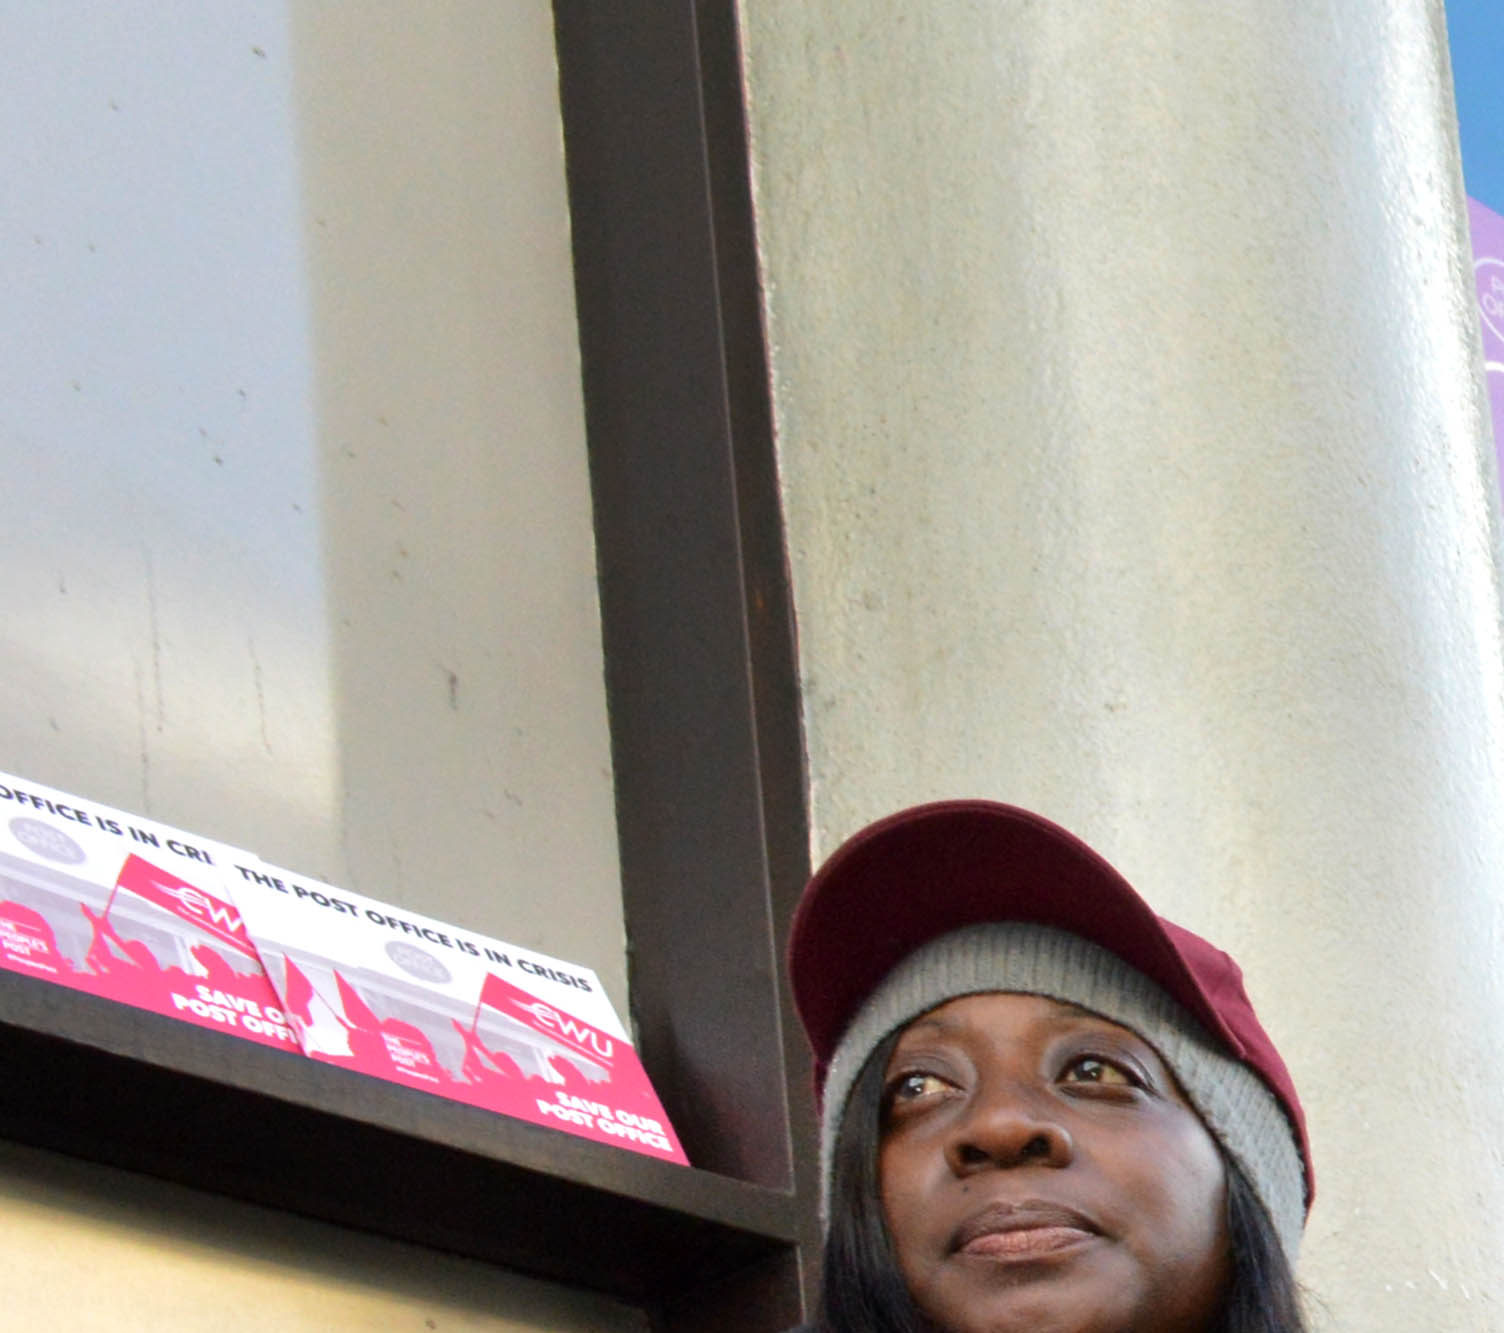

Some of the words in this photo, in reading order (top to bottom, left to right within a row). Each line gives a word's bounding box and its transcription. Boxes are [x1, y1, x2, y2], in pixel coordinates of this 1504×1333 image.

[95, 815, 124, 837] IS
[128, 825, 161, 848] IN
[234, 864, 288, 894] THE
[293, 885, 360, 918] POST
[364, 912, 453, 949] OFFICE
[456, 936, 480, 957] IS
[484, 945, 513, 969] IN
[516, 957, 594, 993] CRISIS
[171, 992, 238, 1027] POST
[195, 984, 258, 1019] SAVE
[532, 1001, 613, 1058] CWU
[535, 1099, 594, 1128] POST
[598, 1119, 674, 1153] OFFICE
[555, 1090, 614, 1120] SAVE
[615, 1109, 666, 1136] OUR
